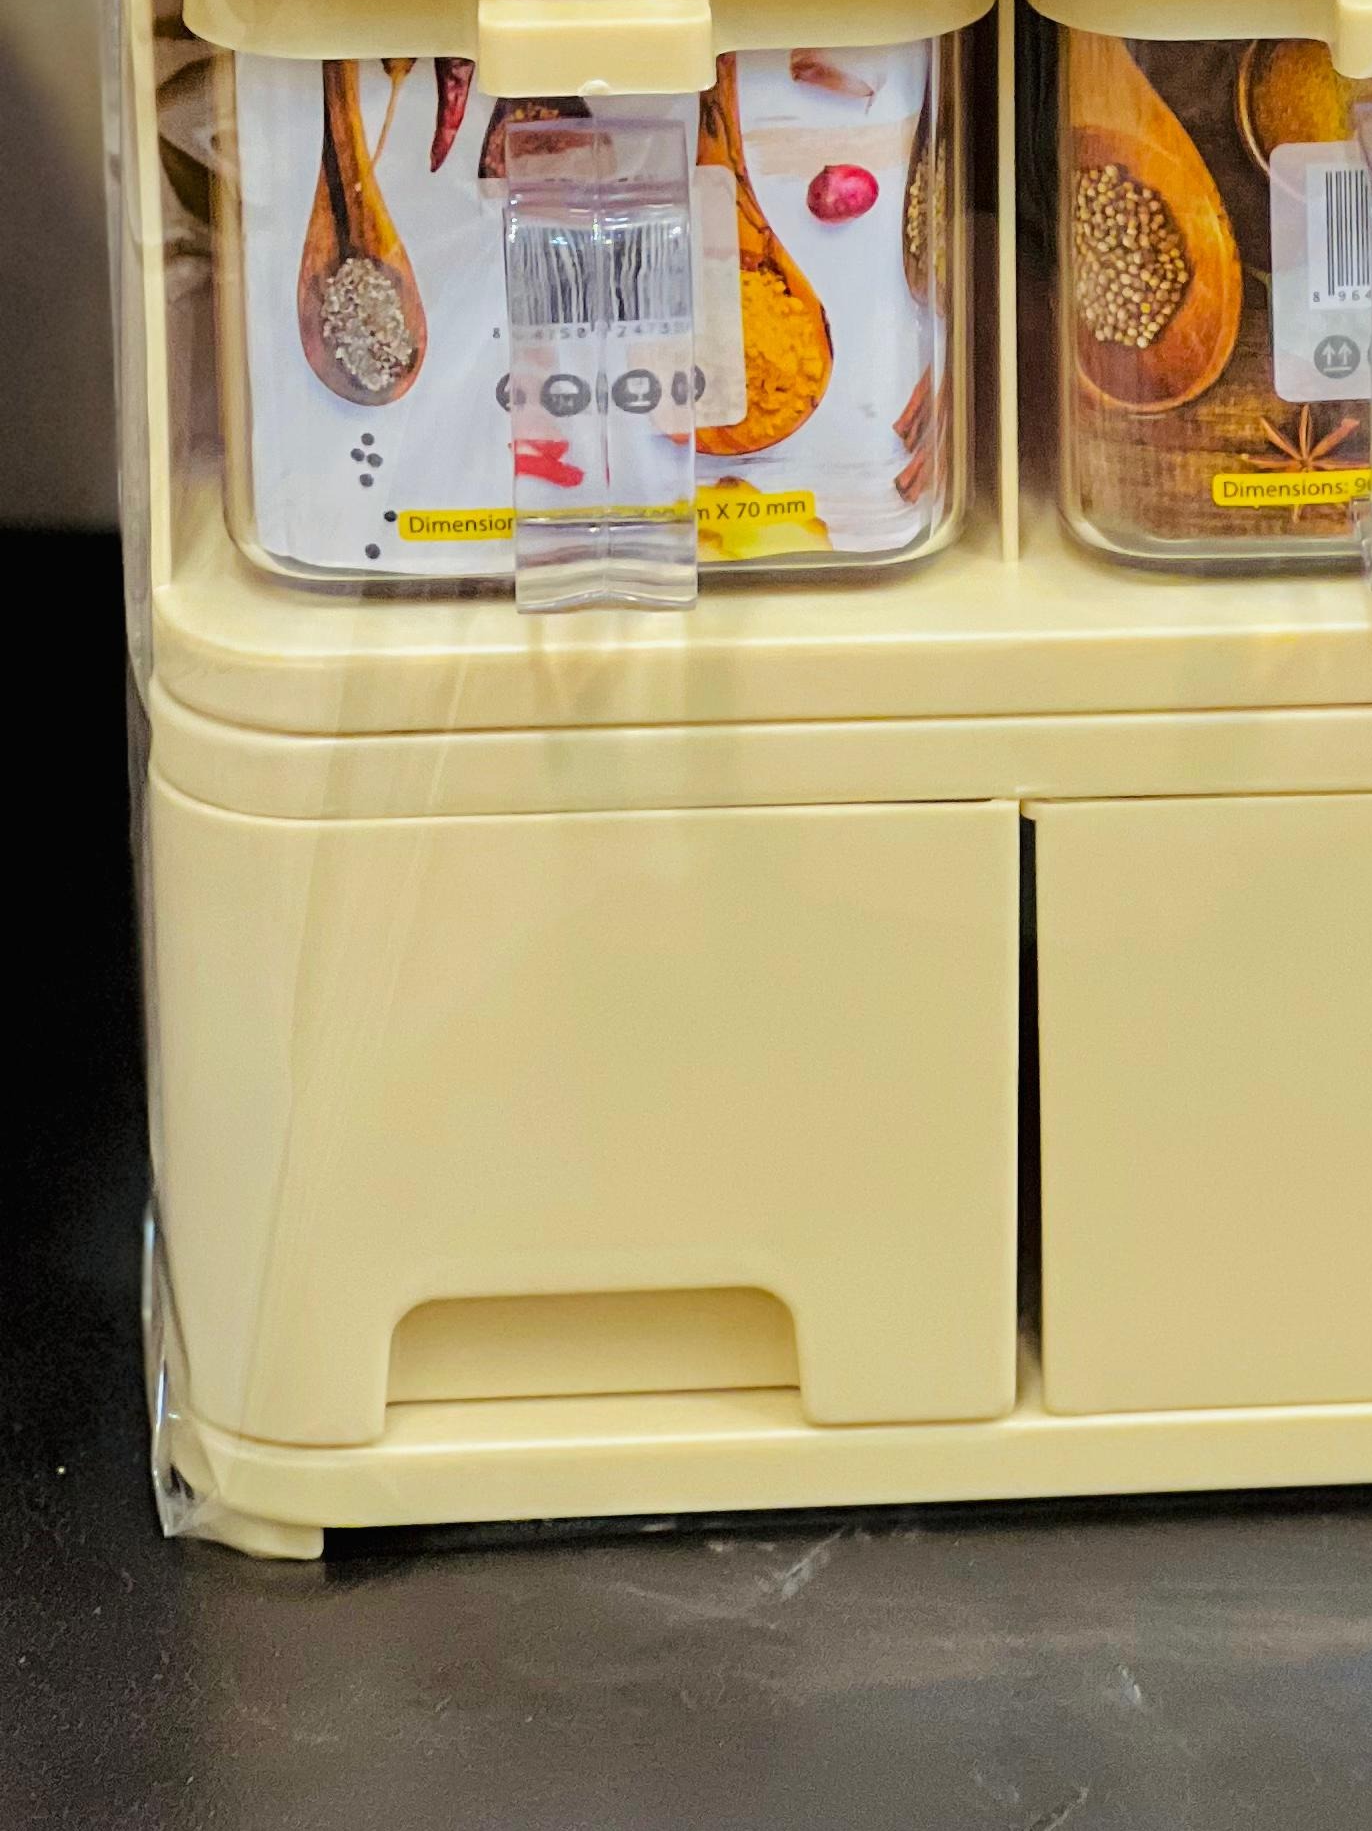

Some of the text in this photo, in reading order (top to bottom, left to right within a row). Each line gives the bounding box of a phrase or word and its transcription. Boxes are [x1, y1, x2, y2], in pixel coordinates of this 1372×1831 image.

[409, 515, 514, 533] Dimensio
[716, 503, 730, 520] X
[737, 501, 761, 518] 70
[767, 499, 806, 516] mm
